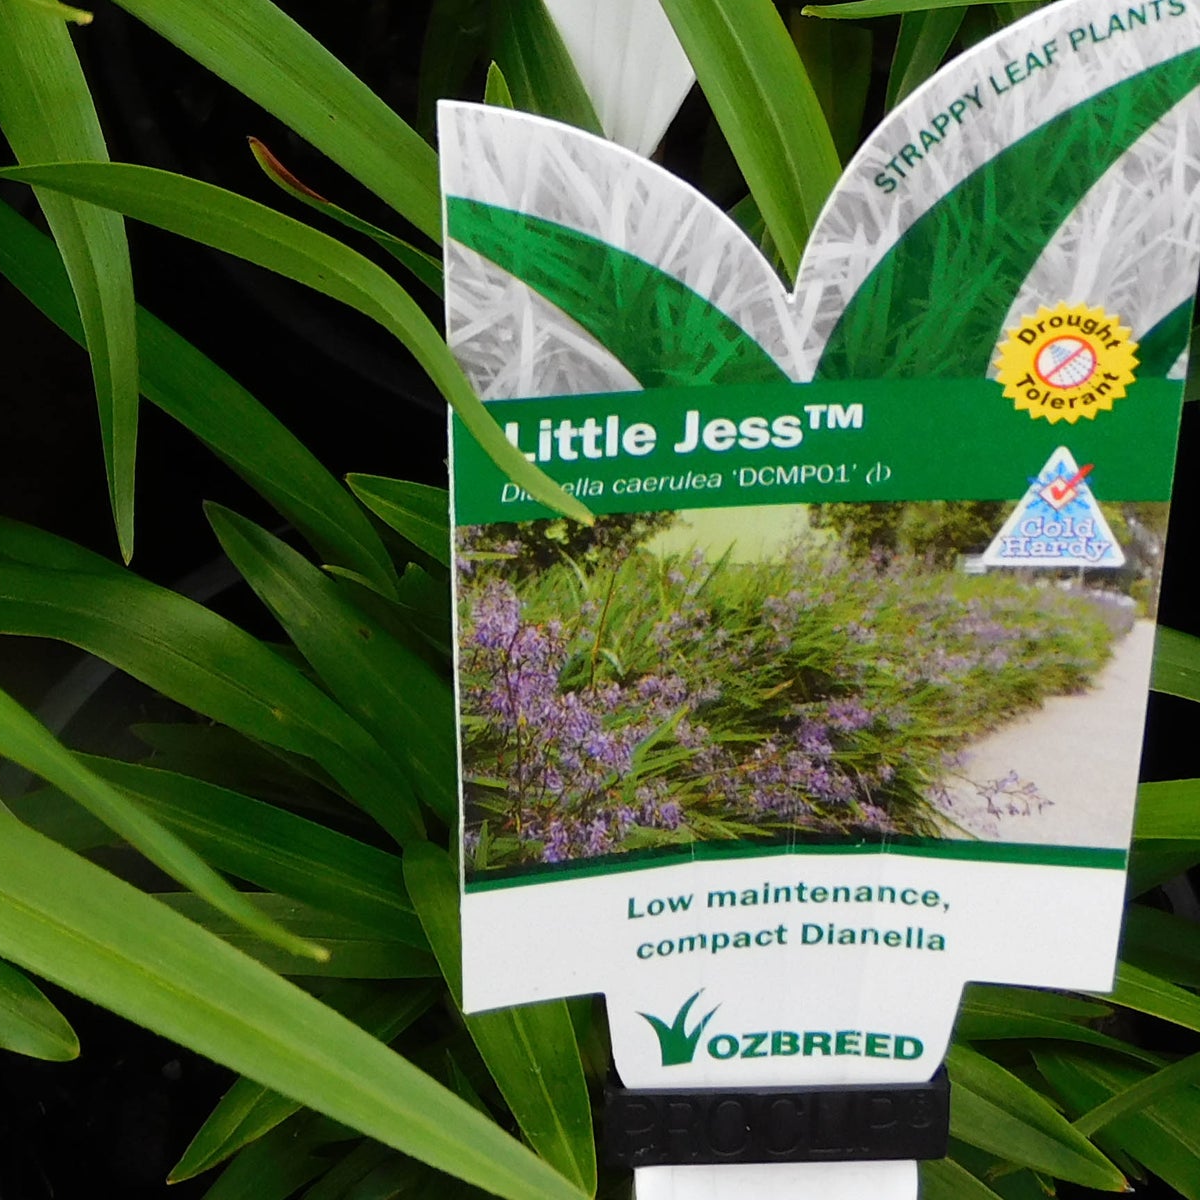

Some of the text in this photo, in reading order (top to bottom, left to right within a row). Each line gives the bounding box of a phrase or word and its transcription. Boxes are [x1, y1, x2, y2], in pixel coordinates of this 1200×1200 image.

[874, 85, 985, 194] STRAPPY
[989, 40, 1059, 95] LEAF
[1017, 314, 1121, 350] Drought
[1016, 372, 1120, 409] Tolerant
[504, 402, 864, 462] Little Jess™
[501, 476, 604, 503] Diella
[612, 470, 723, 493] caerulea
[1019, 516, 1095, 539] Cold
[1001, 536, 1111, 562] Hardy
[627, 882, 950, 920] Low maintenance,
[636, 923, 946, 960] compact Dianella
[707, 1029, 925, 1062] OZBREED
